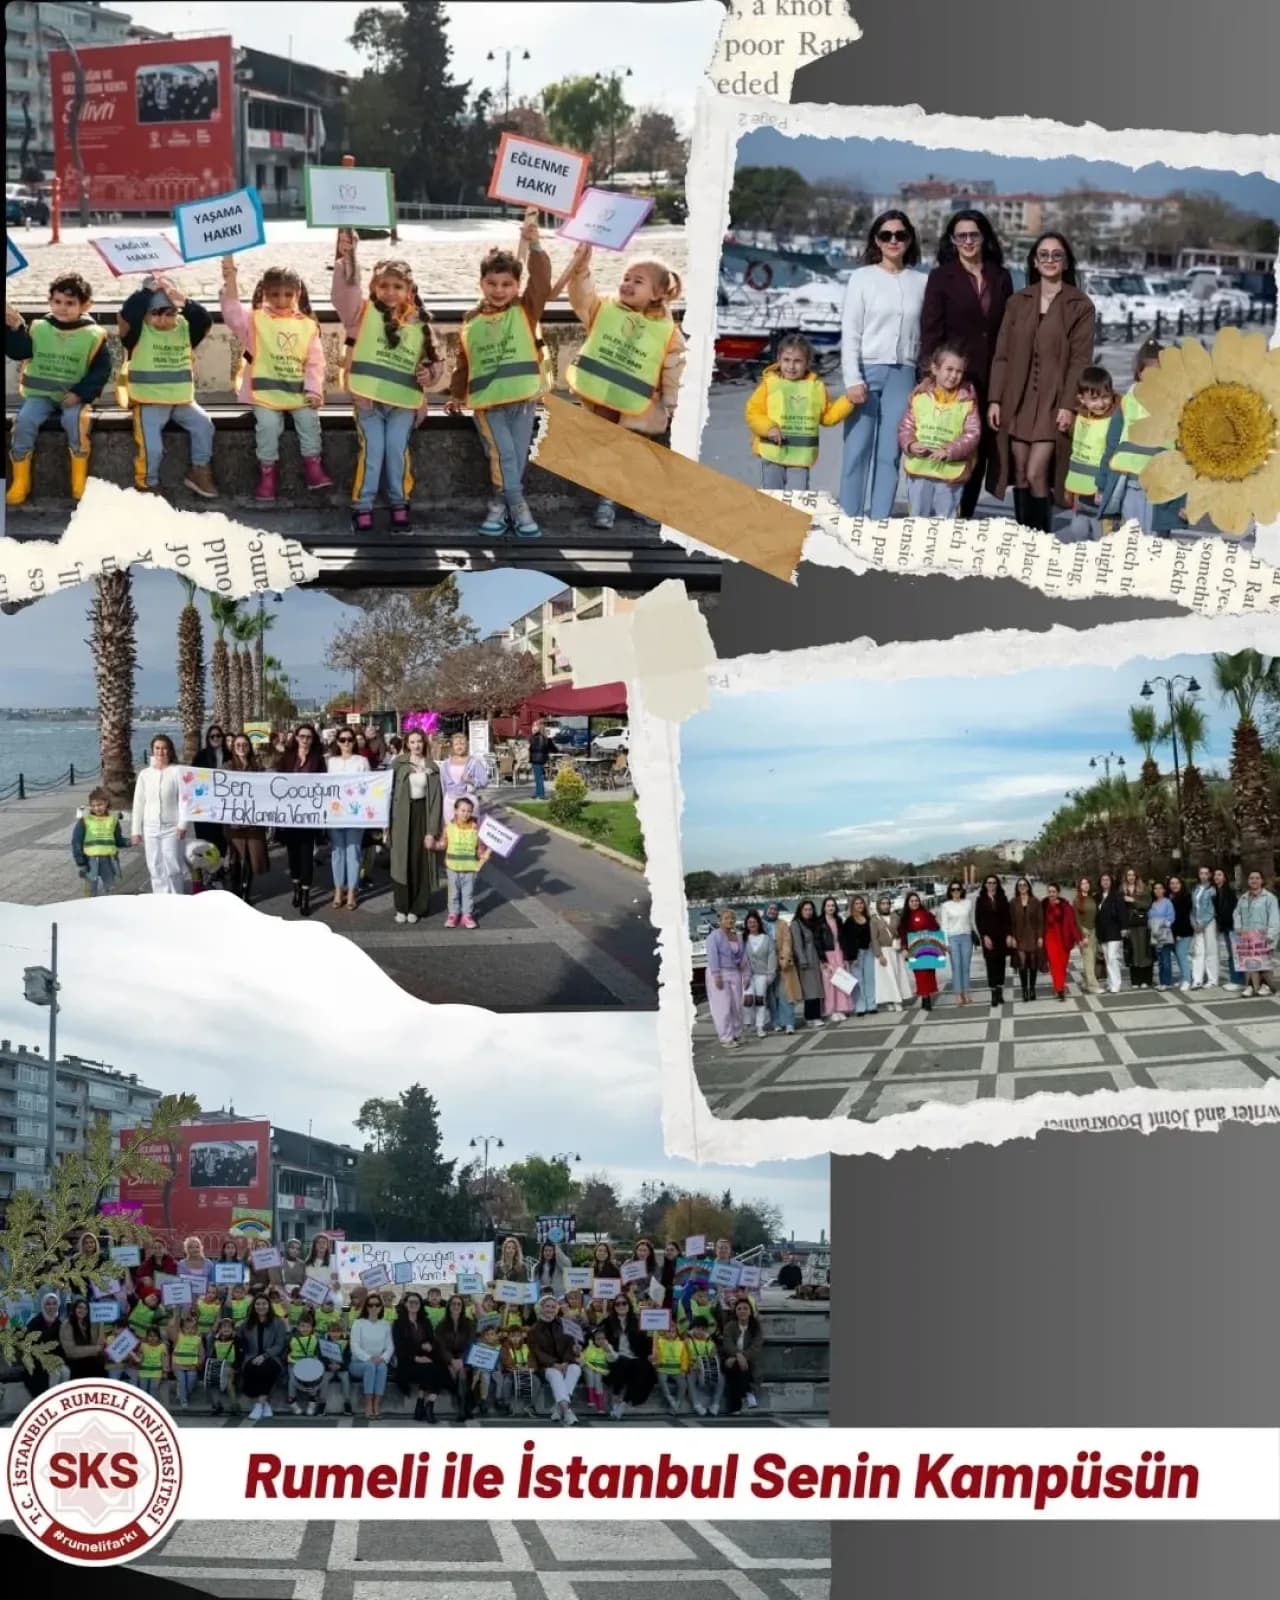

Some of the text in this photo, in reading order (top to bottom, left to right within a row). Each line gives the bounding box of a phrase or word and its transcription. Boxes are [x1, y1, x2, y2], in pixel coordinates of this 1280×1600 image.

[725, 38, 785, 62] poor
[717, 71, 779, 95] eded
[510, 151, 570, 177] EĞLENME
[516, 176, 556, 197] HAKKI
[194, 205, 243, 224] YAŞAMA
[203, 224, 242, 243] HAKKI
[165, 543, 191, 567] of
[1122, 525, 1140, 570] watch
[1046, 558, 1063, 577] all
[1067, 542, 1088, 587] ating,
[1095, 542, 1115, 584] night
[1222, 568, 1238, 587] of
[1242, 580, 1262, 608] Rat
[213, 770, 254, 798] Ben
[1195, 1106, 1226, 1128] and
